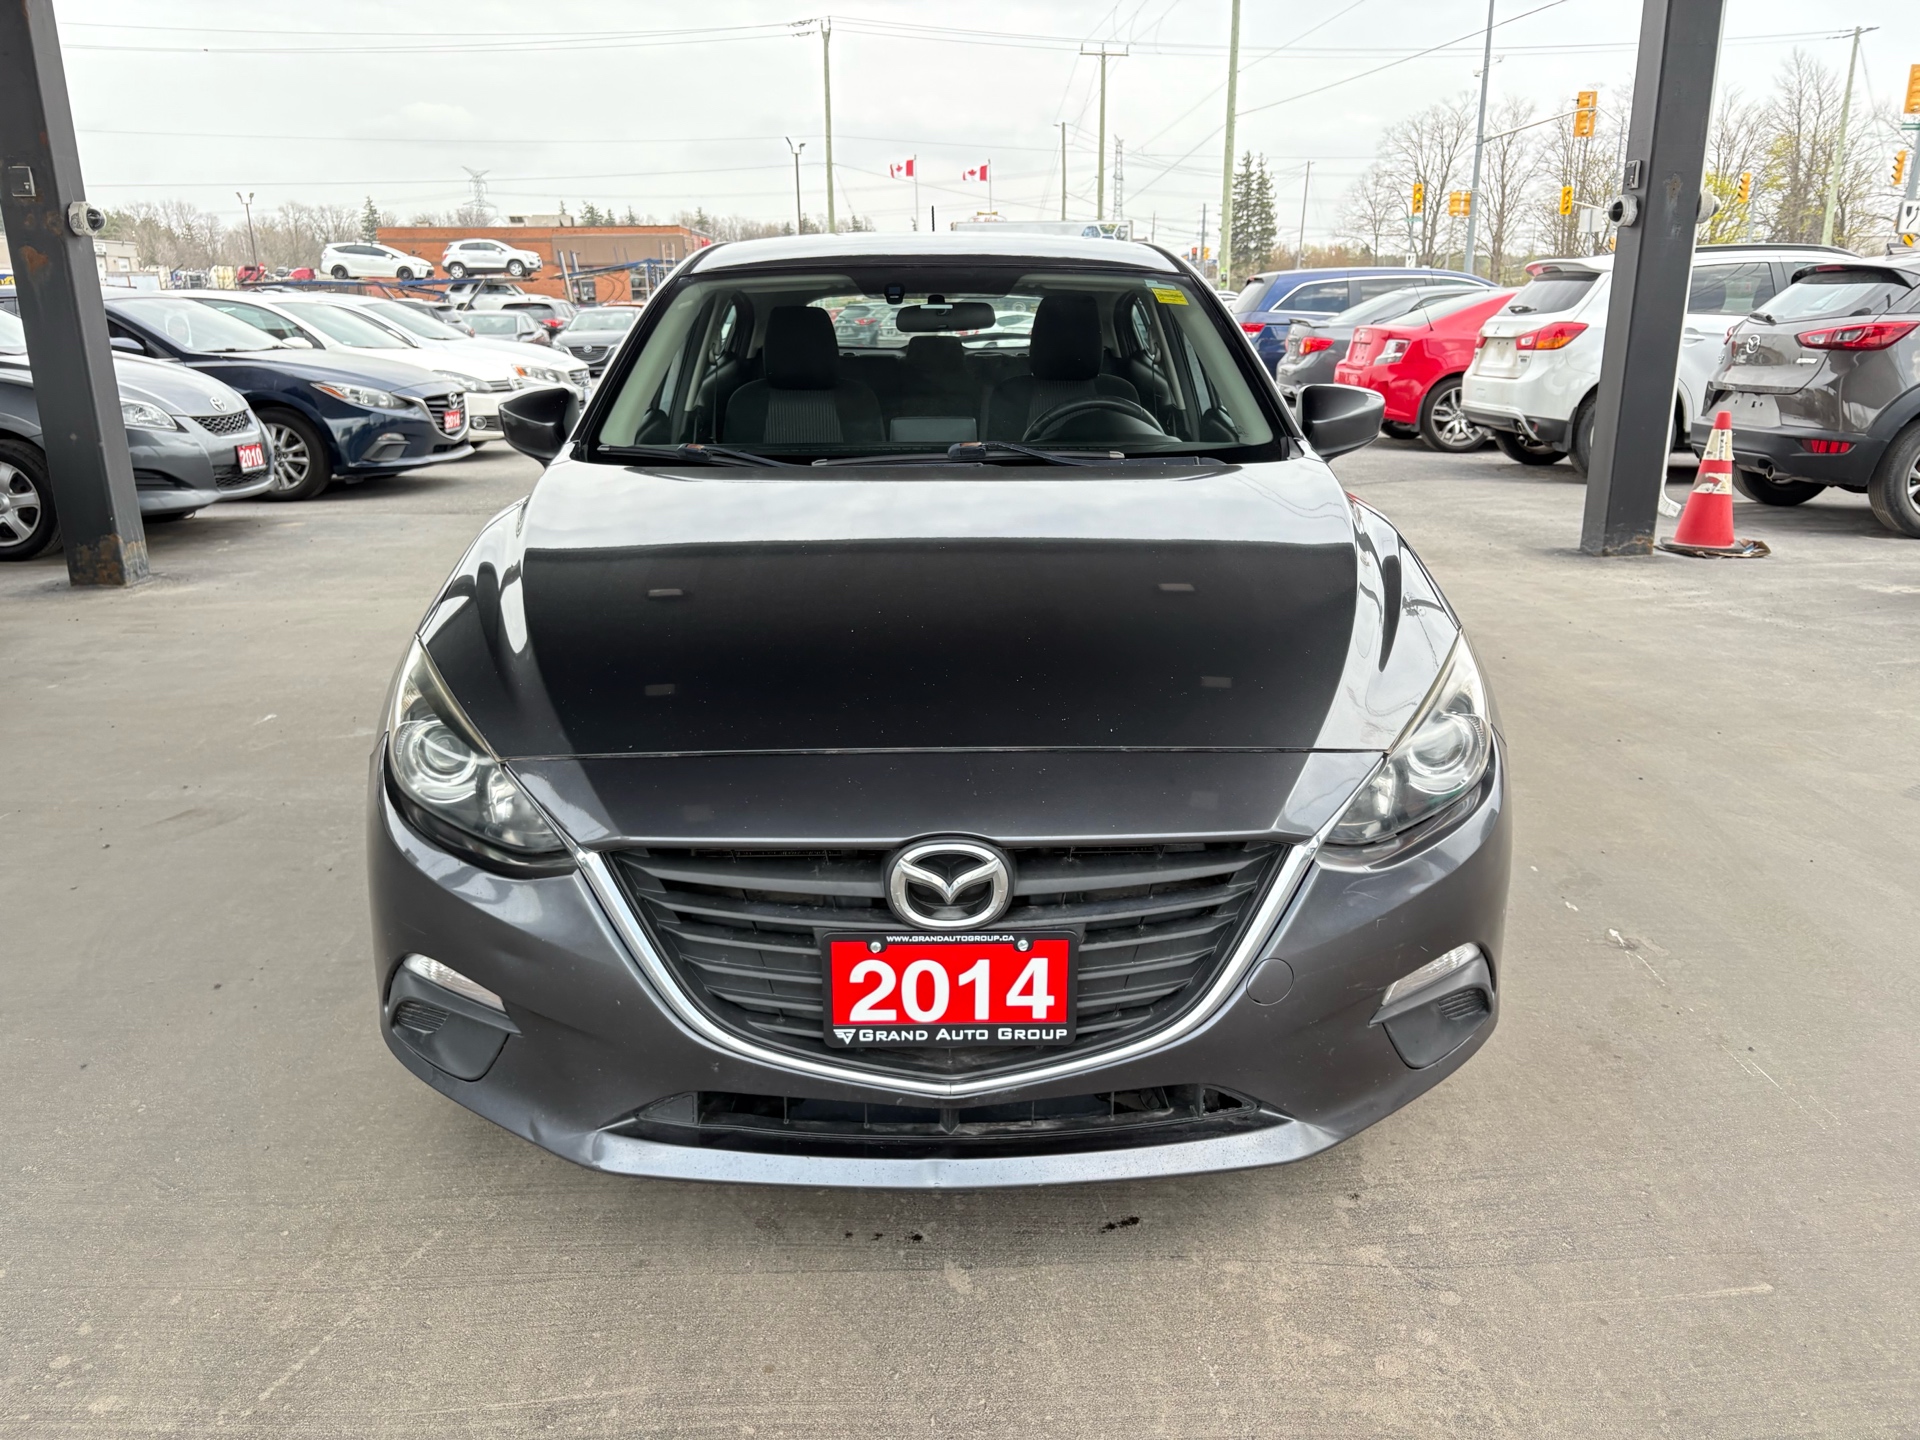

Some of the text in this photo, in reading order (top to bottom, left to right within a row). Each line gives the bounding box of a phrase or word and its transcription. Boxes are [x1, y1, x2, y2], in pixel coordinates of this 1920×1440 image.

[240, 447, 264, 468] 2010
[886, 934, 1015, 943] WWW.GRANDAUTOGROUP.CA
[849, 957, 1055, 1023] 2014
[858, 1027, 1068, 1042] GRAND AUTO GROUP
